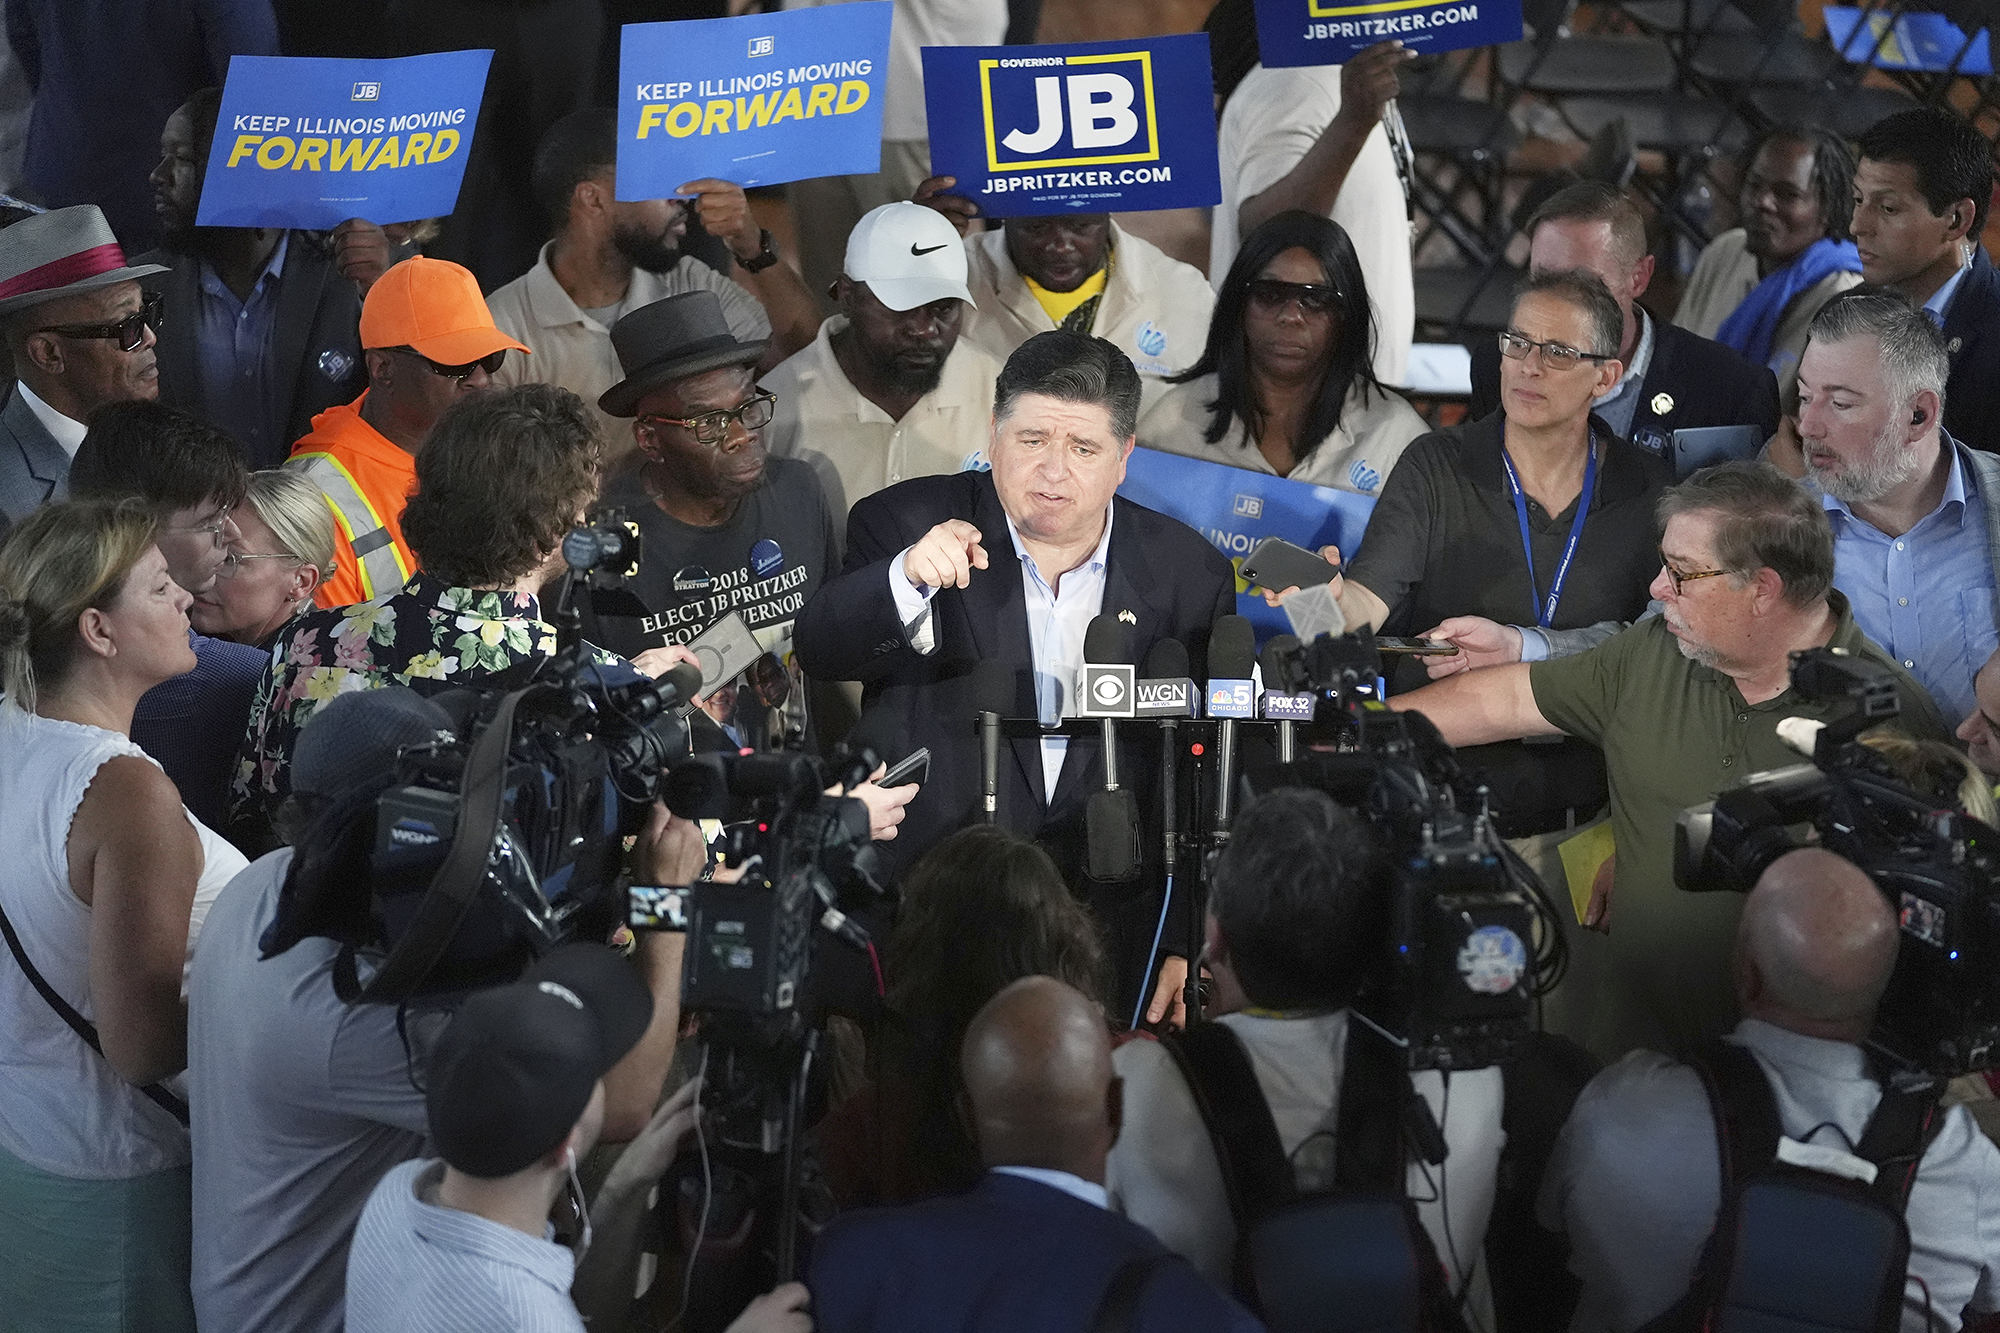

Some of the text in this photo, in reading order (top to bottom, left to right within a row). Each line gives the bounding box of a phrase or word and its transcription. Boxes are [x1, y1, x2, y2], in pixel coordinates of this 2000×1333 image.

[1303, 5, 1478, 40] JBPRITZKER.COM
[749, 40, 772, 55] JB
[1000, 57, 1064, 68] GOVERNOR
[637, 59, 873, 101] KEEP ILLINOIS MOVING
[354, 85, 378, 99] JB
[636, 79, 871, 140] FORWARD
[1001, 73, 1139, 154] JB
[233, 108, 466, 134] KEEP ILLINOIS MOVING
[226, 128, 461, 172] FORWARD
[981, 166, 1172, 194] JBPRITZKER.COM
[328, 355, 344, 375] JB
[1642, 434, 1662, 449] JB
[1236, 500, 1260, 516] JB
[674, 582, 710, 591] STRATTON
[710, 567, 749, 593] 2018
[640, 600, 706, 634] ELECT
[708, 594, 728, 618] JB
[730, 565, 808, 607] PRITZKER
[1137, 683, 1187, 702] WGN
[1233, 685, 1250, 706] 5
[1268, 696, 1309, 710] FOX 32
